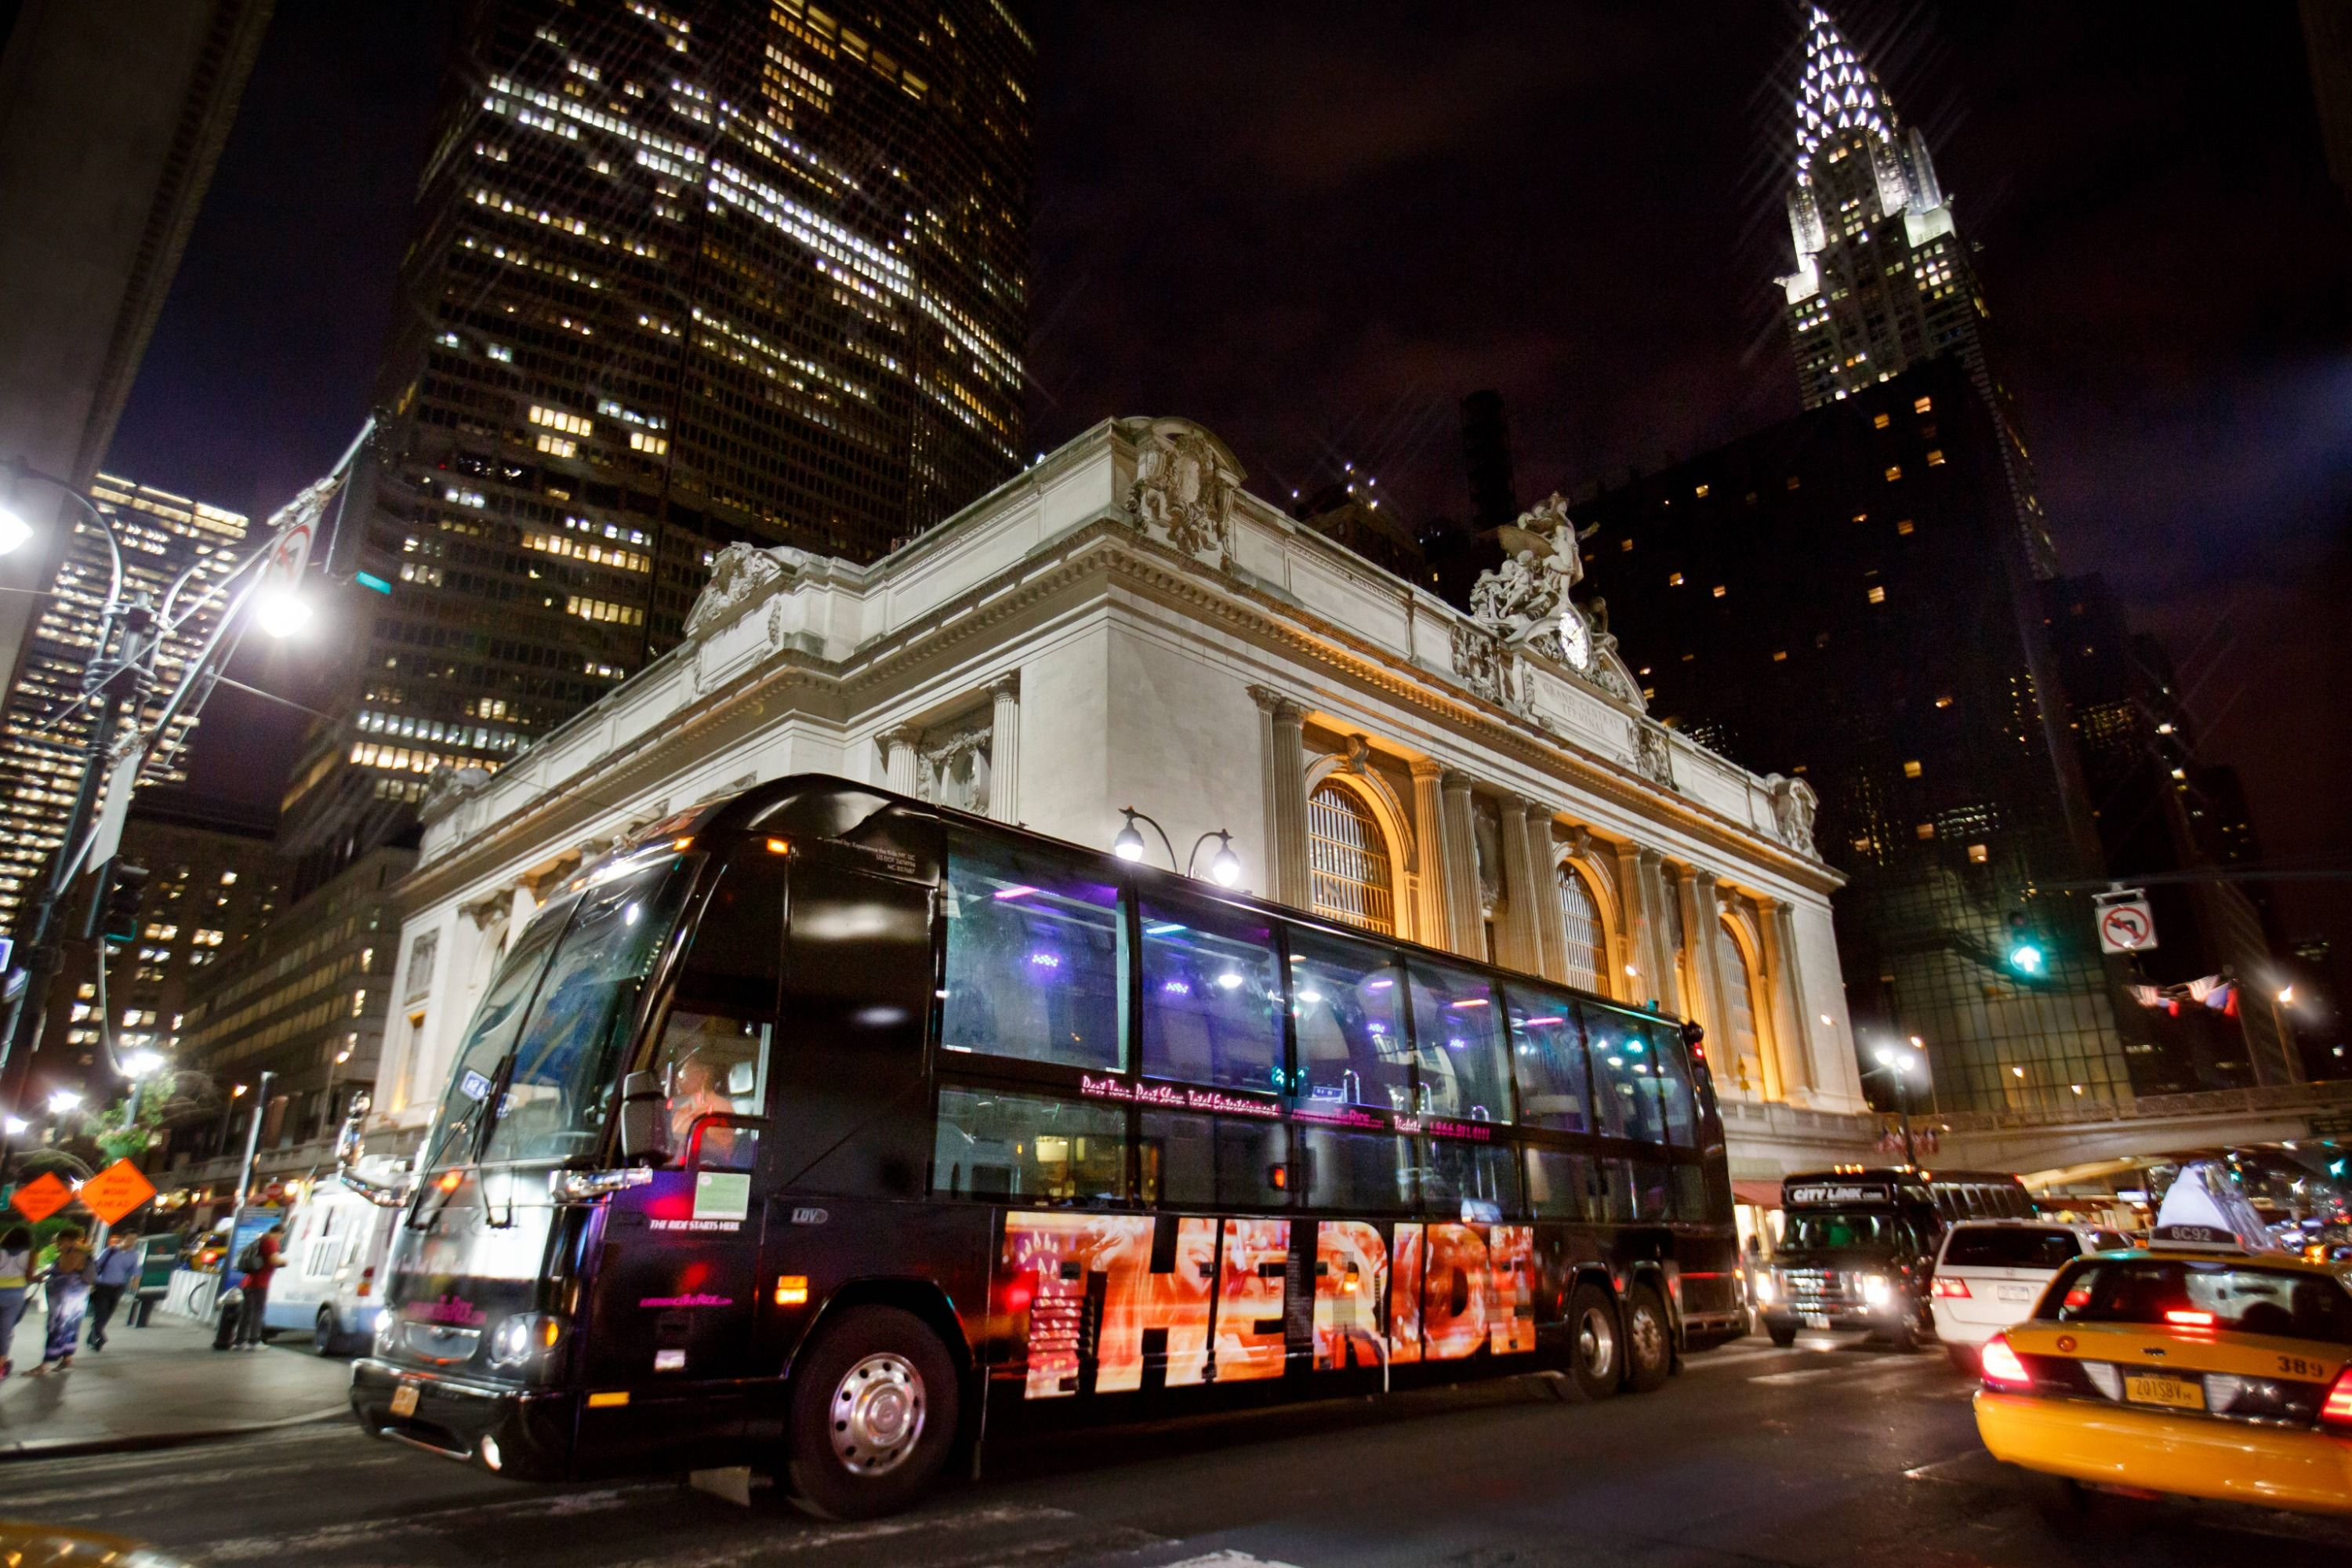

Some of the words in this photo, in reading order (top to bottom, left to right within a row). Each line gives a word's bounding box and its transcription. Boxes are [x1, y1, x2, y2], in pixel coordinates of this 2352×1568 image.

[1543, 682, 1574, 706] GRAND
[689, 1220, 718, 1231] STARTS
[2171, 1227, 2211, 1241] 6C92
[1005, 1211, 1291, 1400] THE
[1313, 1221, 1536, 1371] RIDE
[2277, 1356, 2323, 1377] 389
